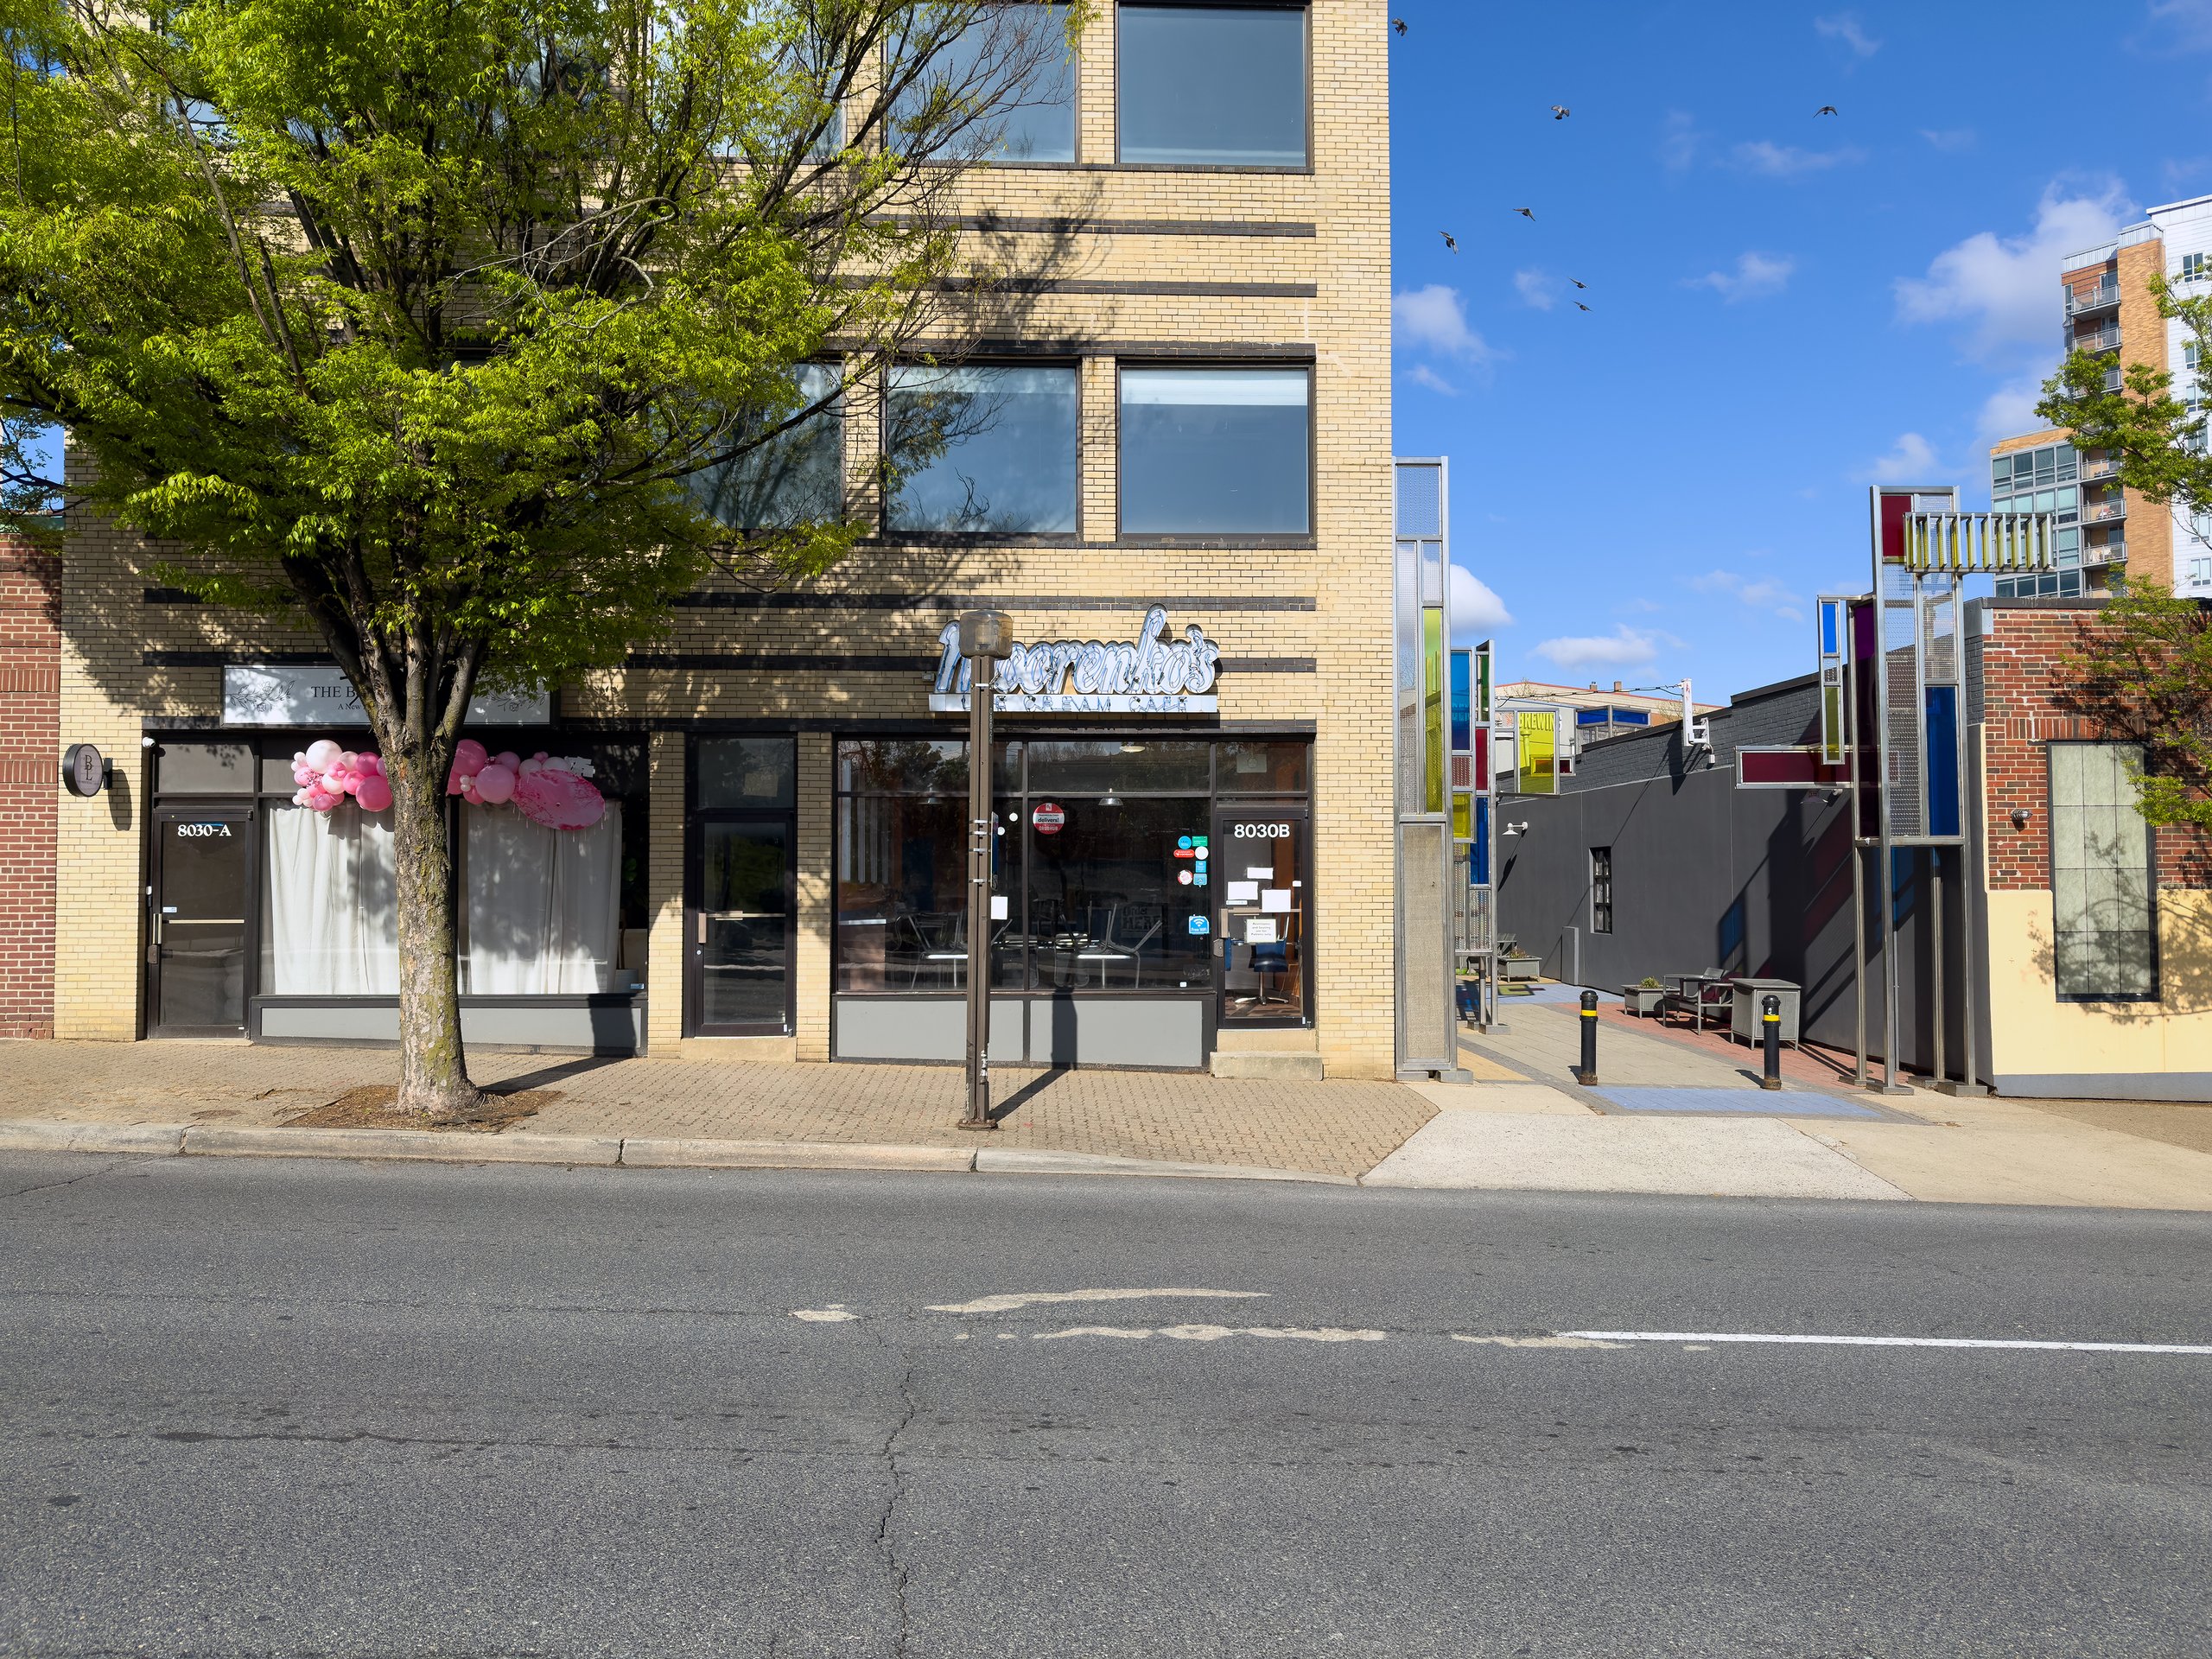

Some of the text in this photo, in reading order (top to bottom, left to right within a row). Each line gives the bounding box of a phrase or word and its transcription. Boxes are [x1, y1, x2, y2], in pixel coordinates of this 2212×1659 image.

[310, 685, 342, 698] THE
[1023, 695, 1113, 713] CREAM
[177, 823, 232, 837] 8030-A
[1233, 823, 1291, 838] 8030B
